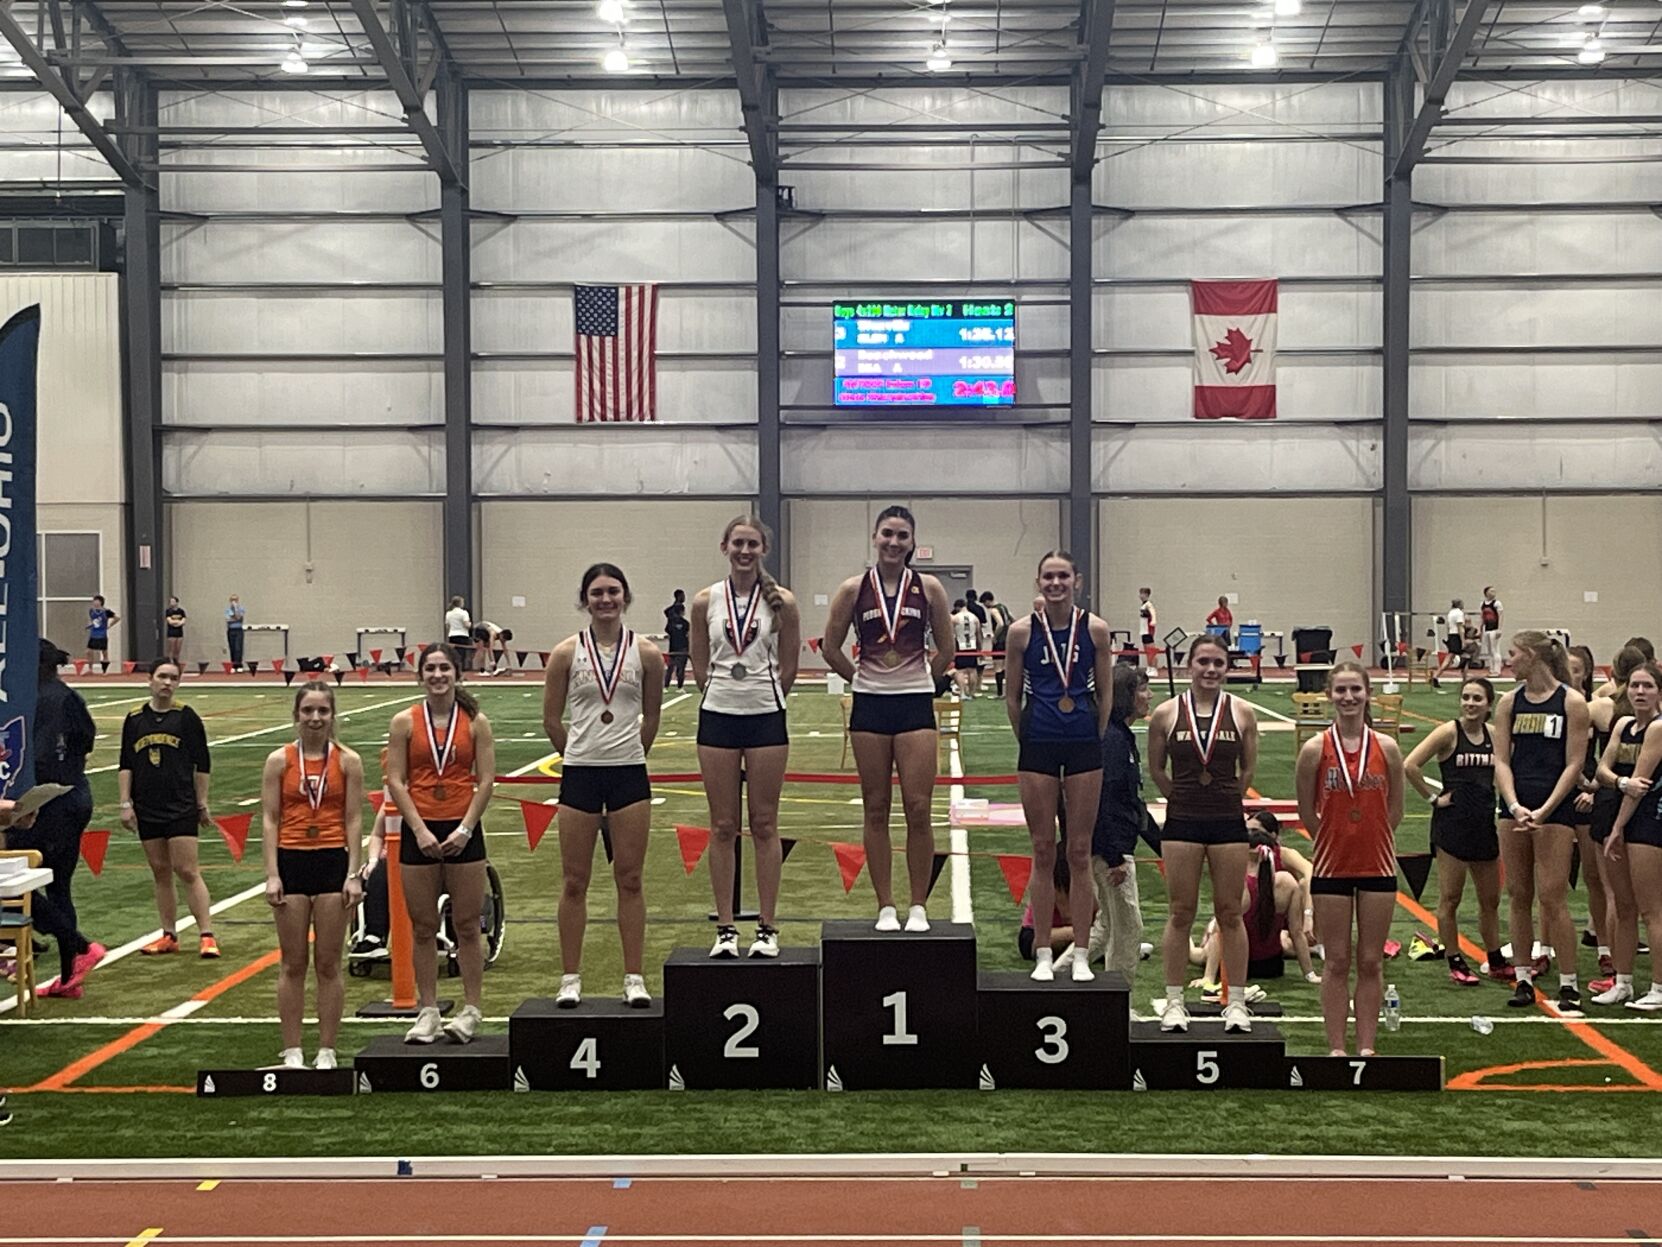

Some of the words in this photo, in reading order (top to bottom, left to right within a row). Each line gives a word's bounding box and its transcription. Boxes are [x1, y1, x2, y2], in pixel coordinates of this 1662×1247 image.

[1550, 716, 1557, 736] 1
[724, 1004, 759, 1057] 2
[883, 992, 917, 1044] 1
[1035, 1017, 1068, 1063] 3
[570, 1038, 600, 1077] 4
[1196, 1051, 1219, 1084] 5
[1350, 1061, 1366, 1085] 7
[263, 1073, 277, 1091] 8
[420, 1063, 440, 1089] 6
